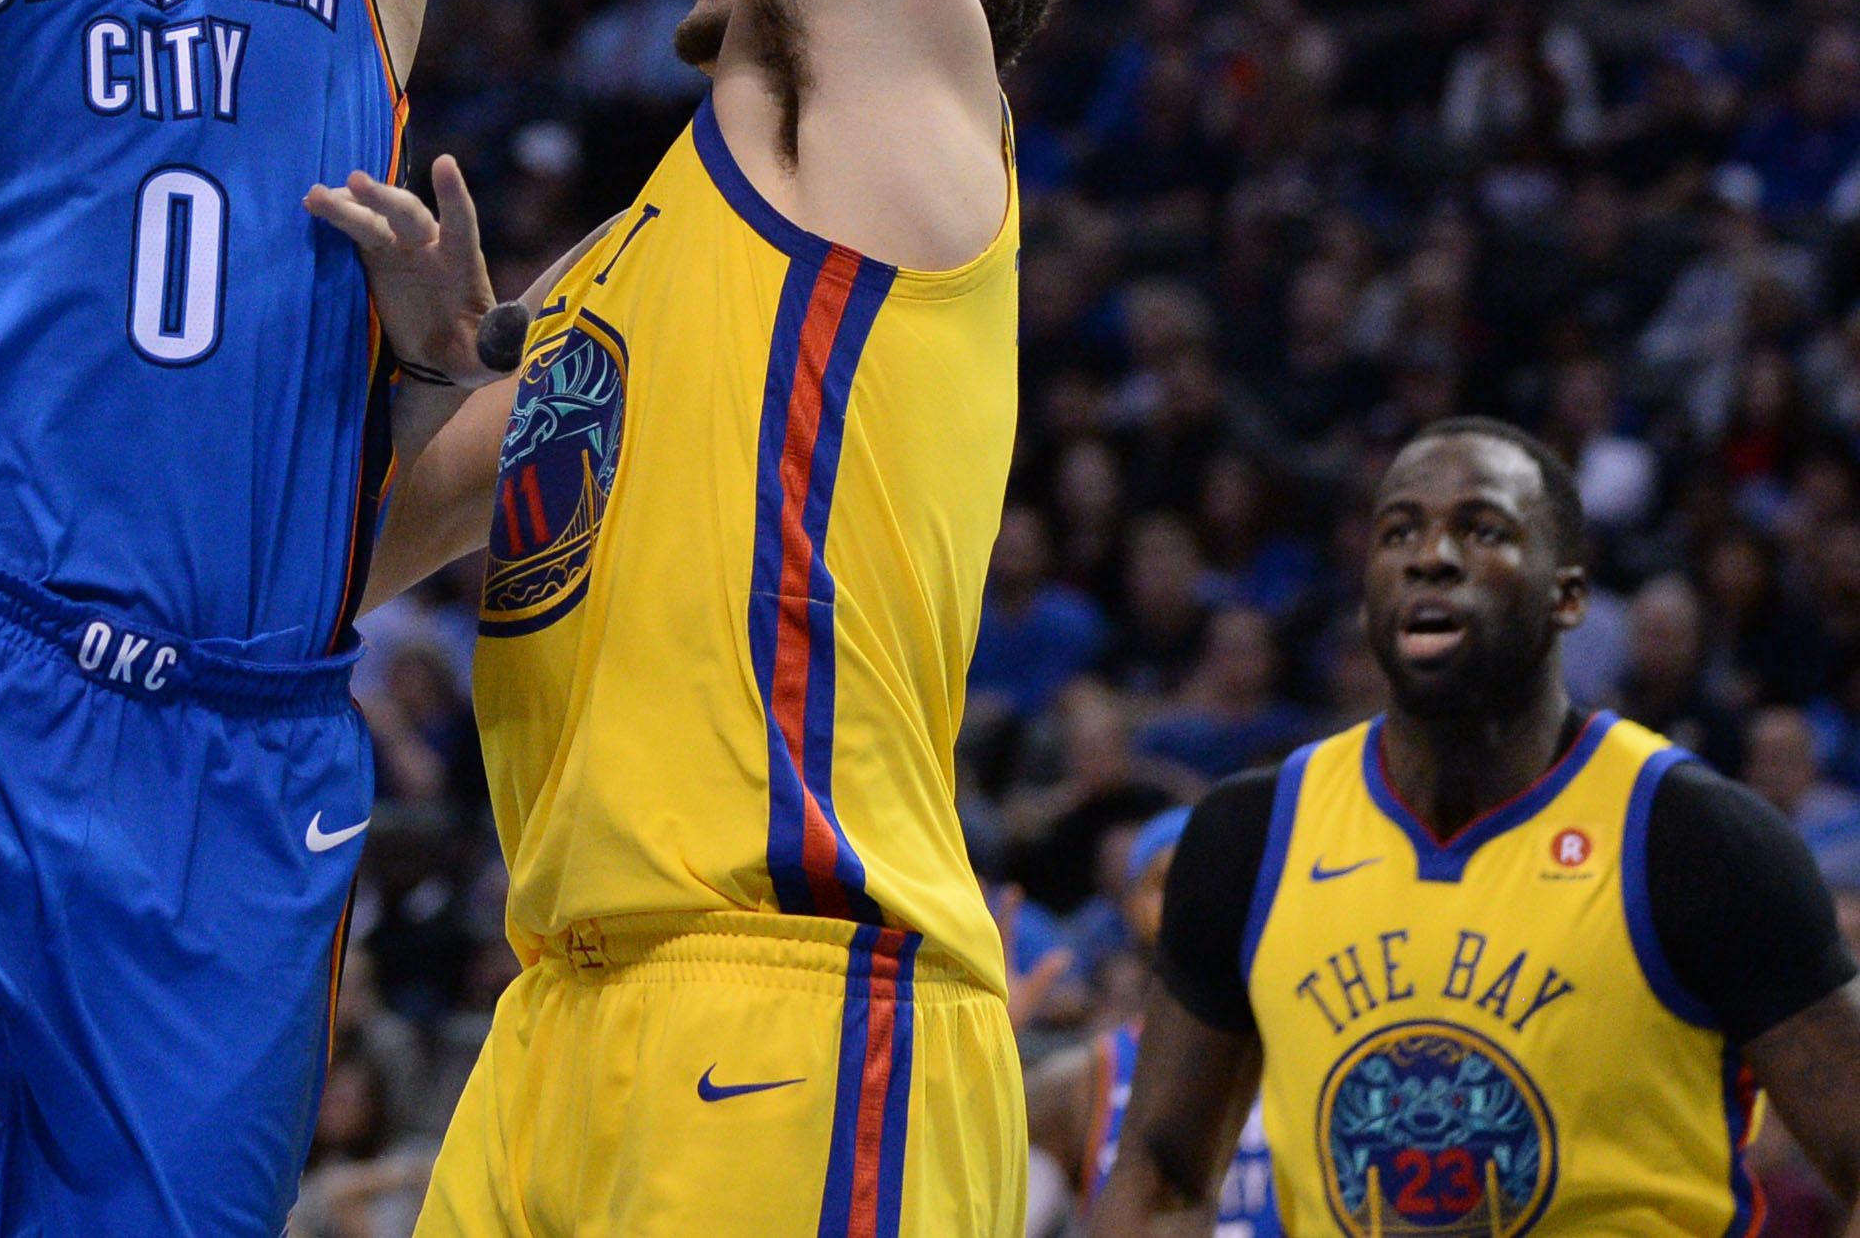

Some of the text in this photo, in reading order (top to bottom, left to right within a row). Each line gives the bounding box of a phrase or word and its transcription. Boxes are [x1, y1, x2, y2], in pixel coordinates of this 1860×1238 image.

[84, 15, 250, 123] CITY
[126, 164, 230, 369] 0
[501, 464, 551, 558] 11
[78, 621, 177, 691] OKC
[1295, 929, 1575, 1034] THE BAY
[1395, 1147, 1483, 1215] 23
